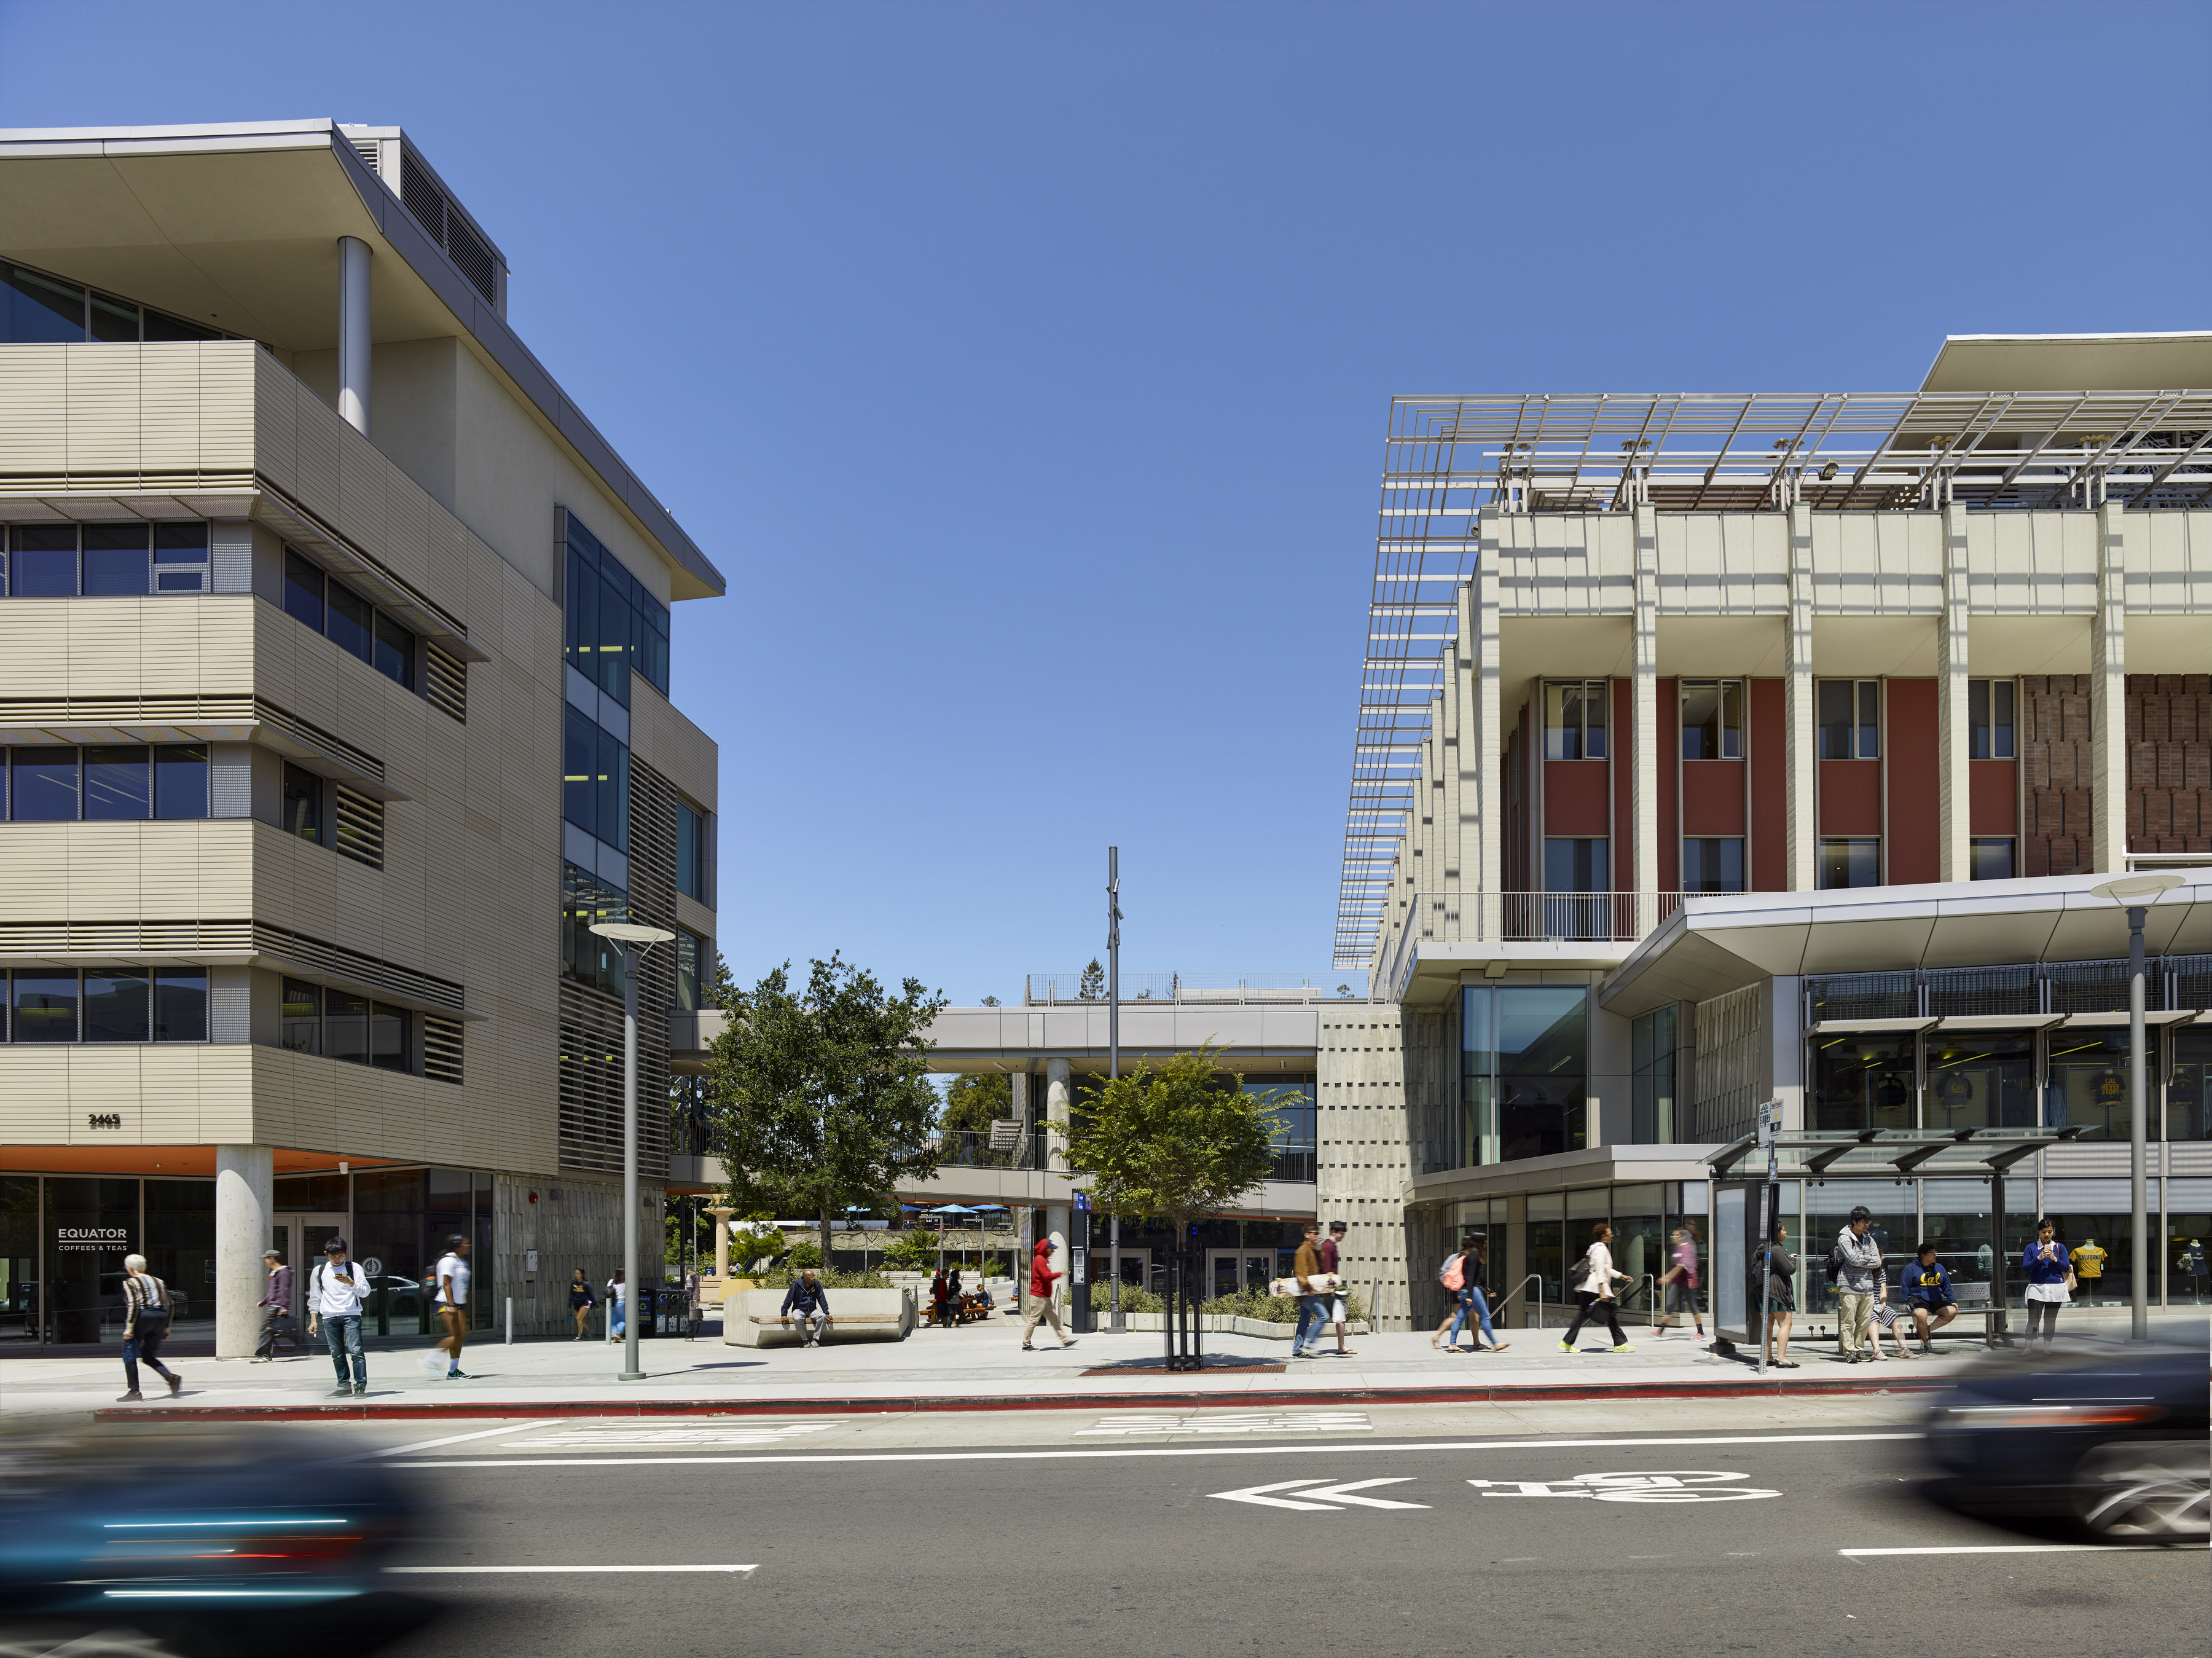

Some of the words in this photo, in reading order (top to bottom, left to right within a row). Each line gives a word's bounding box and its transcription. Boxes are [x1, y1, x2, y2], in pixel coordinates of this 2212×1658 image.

[1951, 1081, 1965, 1093] Cal
[88, 1114, 120, 1125] 2465
[58, 1228, 127, 1238] EQUATOR
[1920, 1271, 1940, 1286] Cal
[1074, 1412, 1373, 1436] BUS
